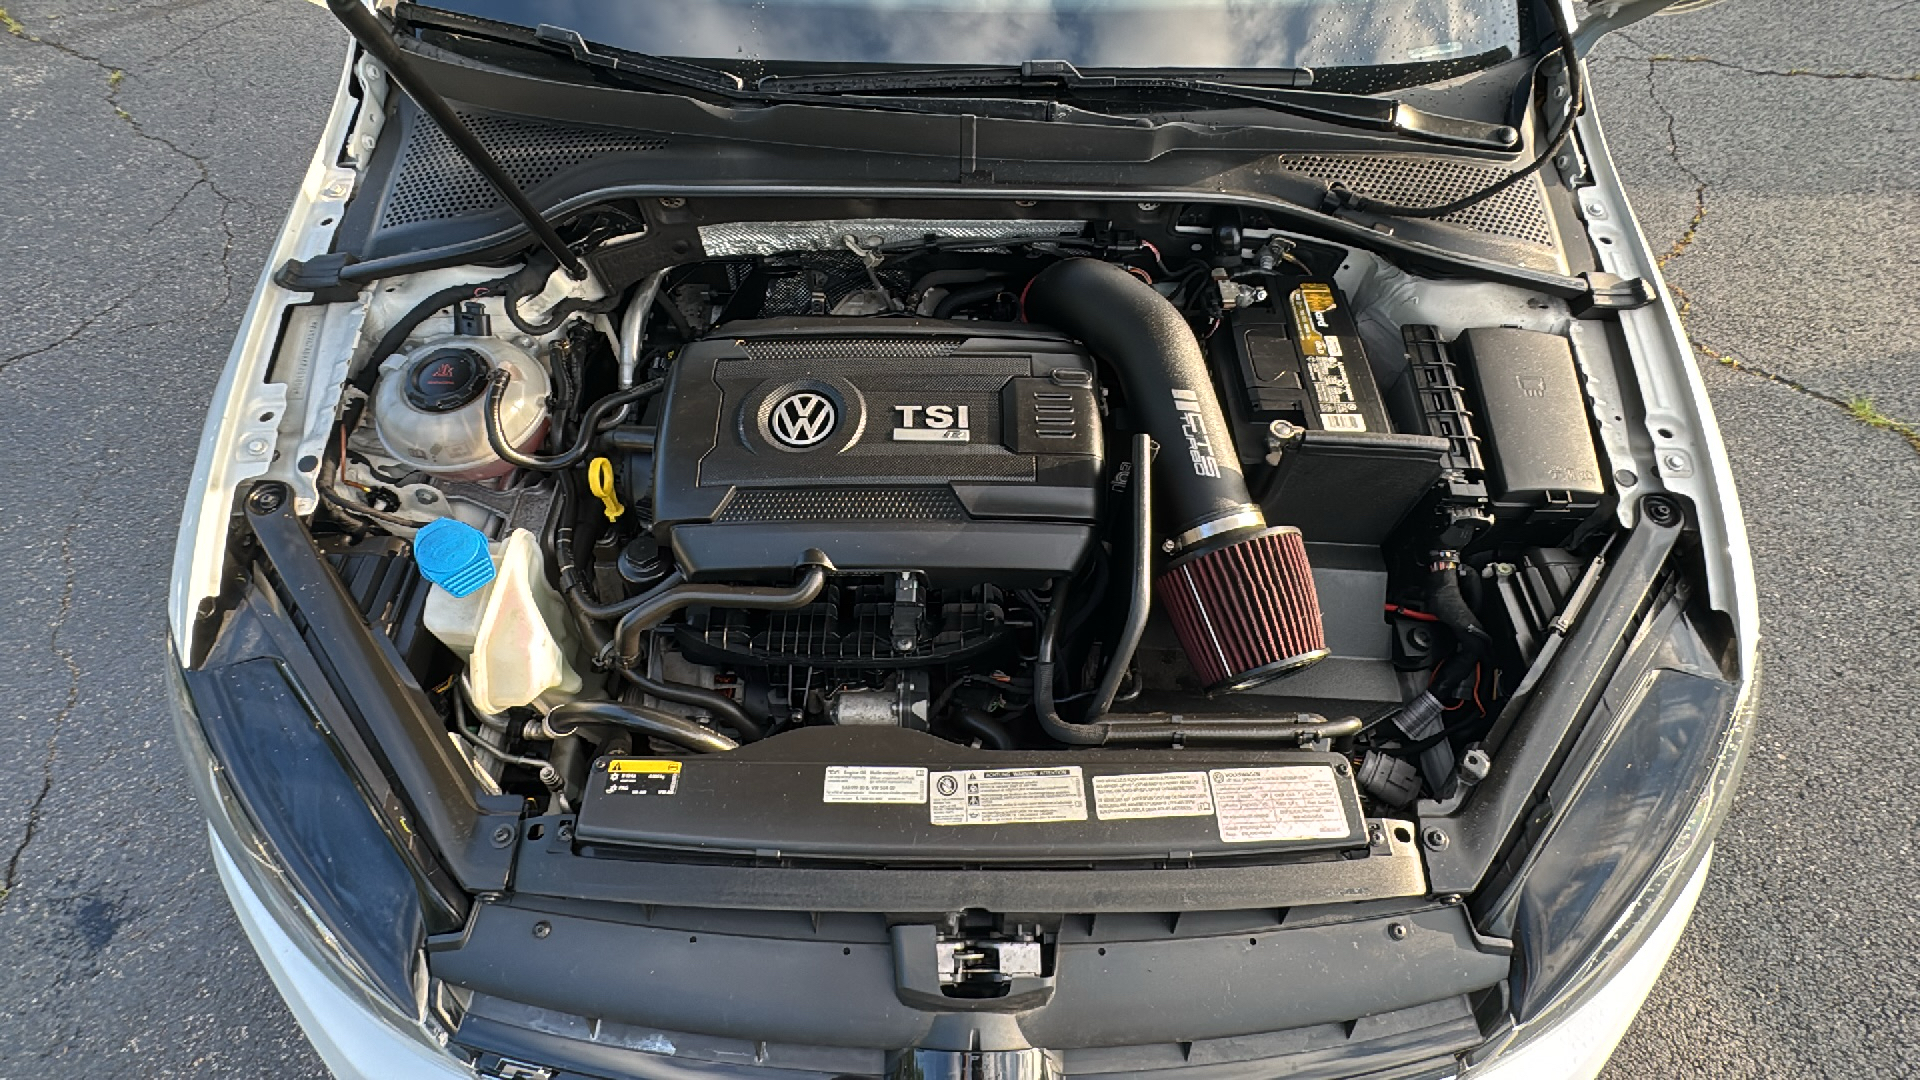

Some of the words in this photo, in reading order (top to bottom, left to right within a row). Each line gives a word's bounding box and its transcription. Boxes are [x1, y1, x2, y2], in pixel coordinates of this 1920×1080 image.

[894, 405, 969, 429] TSI
[1180, 412, 1205, 476] TURBO
[1187, 412, 1221, 479] CTS
